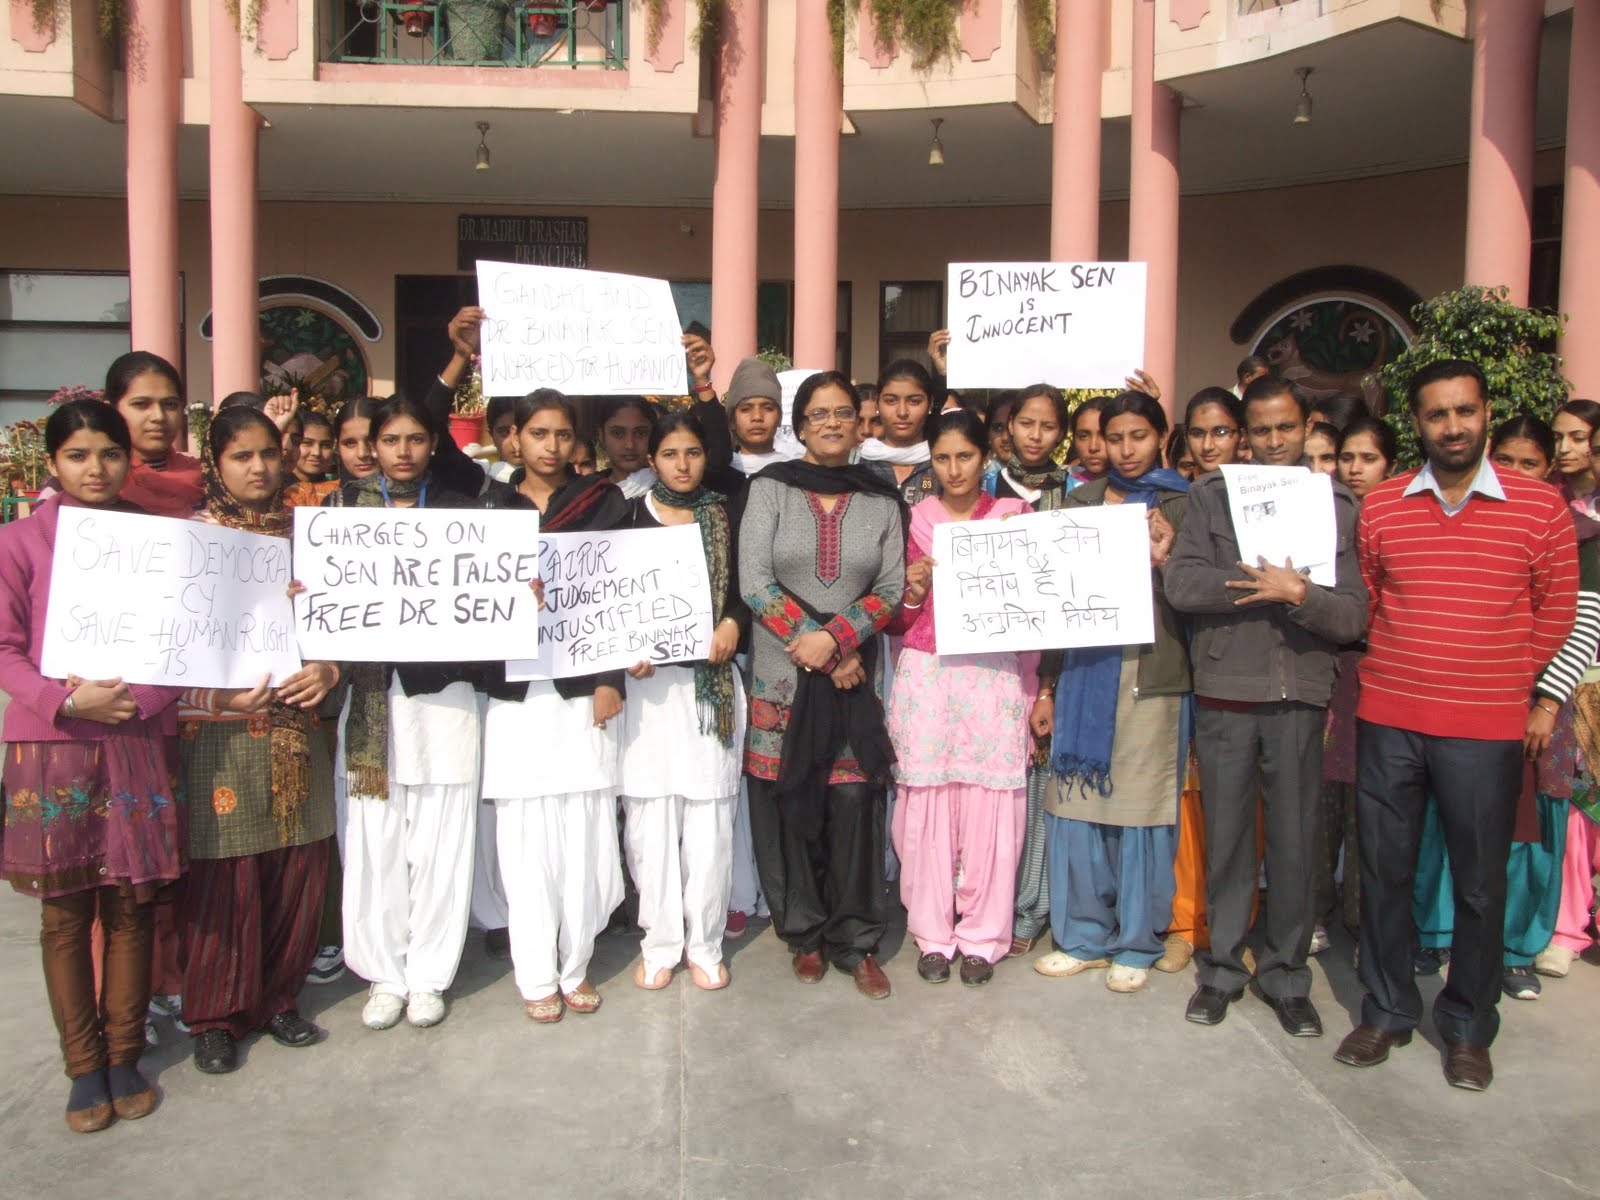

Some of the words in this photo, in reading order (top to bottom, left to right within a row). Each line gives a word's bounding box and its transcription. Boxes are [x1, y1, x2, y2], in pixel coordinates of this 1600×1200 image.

[529, 219, 586, 244] PRASHAR
[514, 244, 586, 268] PRINCIPAL
[959, 266, 1061, 298] BINAYAK
[1070, 264, 1116, 289] SEN
[486, 319, 512, 345] DR
[631, 314, 676, 347] SEN
[966, 312, 1073, 343] INNOCENT
[604, 350, 685, 388] HUMANITY
[1237, 473, 1259, 483] Free
[1239, 480, 1278, 495] Binayak
[307, 510, 429, 549] CHARGES
[446, 521, 487, 545] ON
[1052, 510, 1101, 554] सेन
[72, 517, 172, 573] SAVE
[180, 530, 288, 584] DEMOCRA
[323, 555, 378, 587] SEN
[392, 554, 442, 588] ARE
[452, 552, 538, 587] FALSE
[545, 568, 661, 614] JUDGEMENT
[60, 604, 137, 647] SAVE
[301, 592, 385, 634] FREE
[399, 597, 439, 626] DR
[453, 592, 516, 625] SEN
[567, 637, 619, 667] FREE
[624, 622, 704, 653] BINAYAK
[650, 640, 696, 662] SEN
